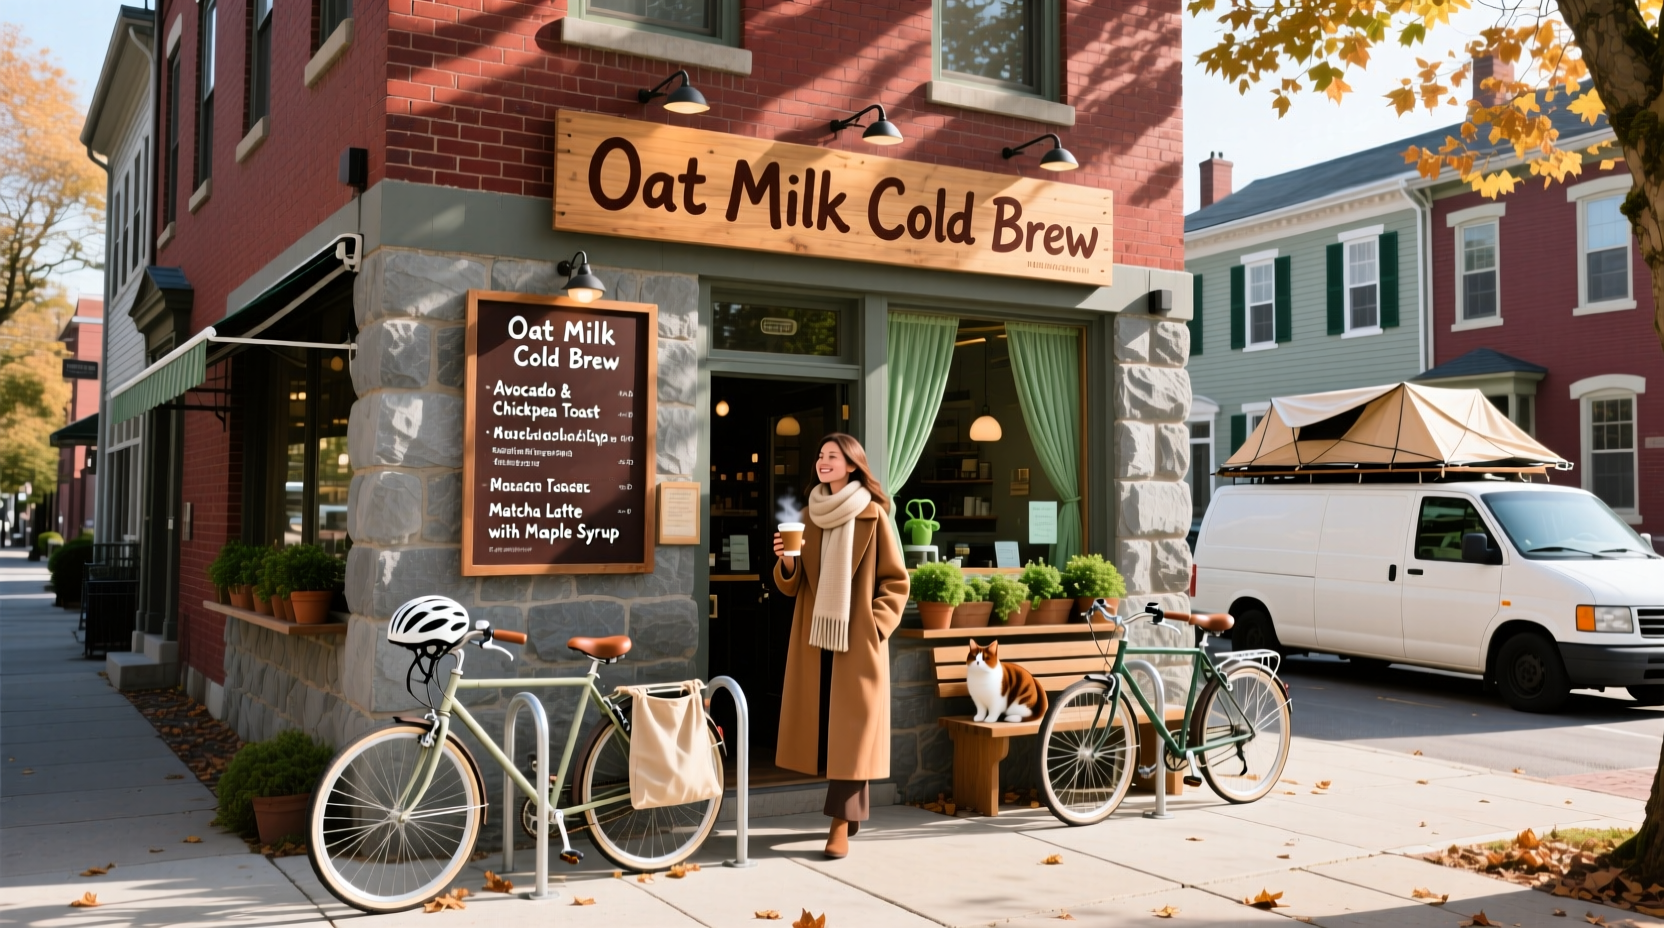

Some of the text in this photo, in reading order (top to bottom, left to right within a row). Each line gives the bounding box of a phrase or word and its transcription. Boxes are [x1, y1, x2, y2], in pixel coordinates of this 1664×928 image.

[587, 136, 1099, 259] Oat Milk Cold Brew
[507, 315, 616, 346] Oat Milk
[513, 344, 620, 371] Cold Brew
[493, 379, 572, 399] Avocado &
[492, 400, 601, 422] Chickpea Toast
[488, 501, 583, 519] Matcha Latte
[488, 522, 620, 546] with Maple Syrup
